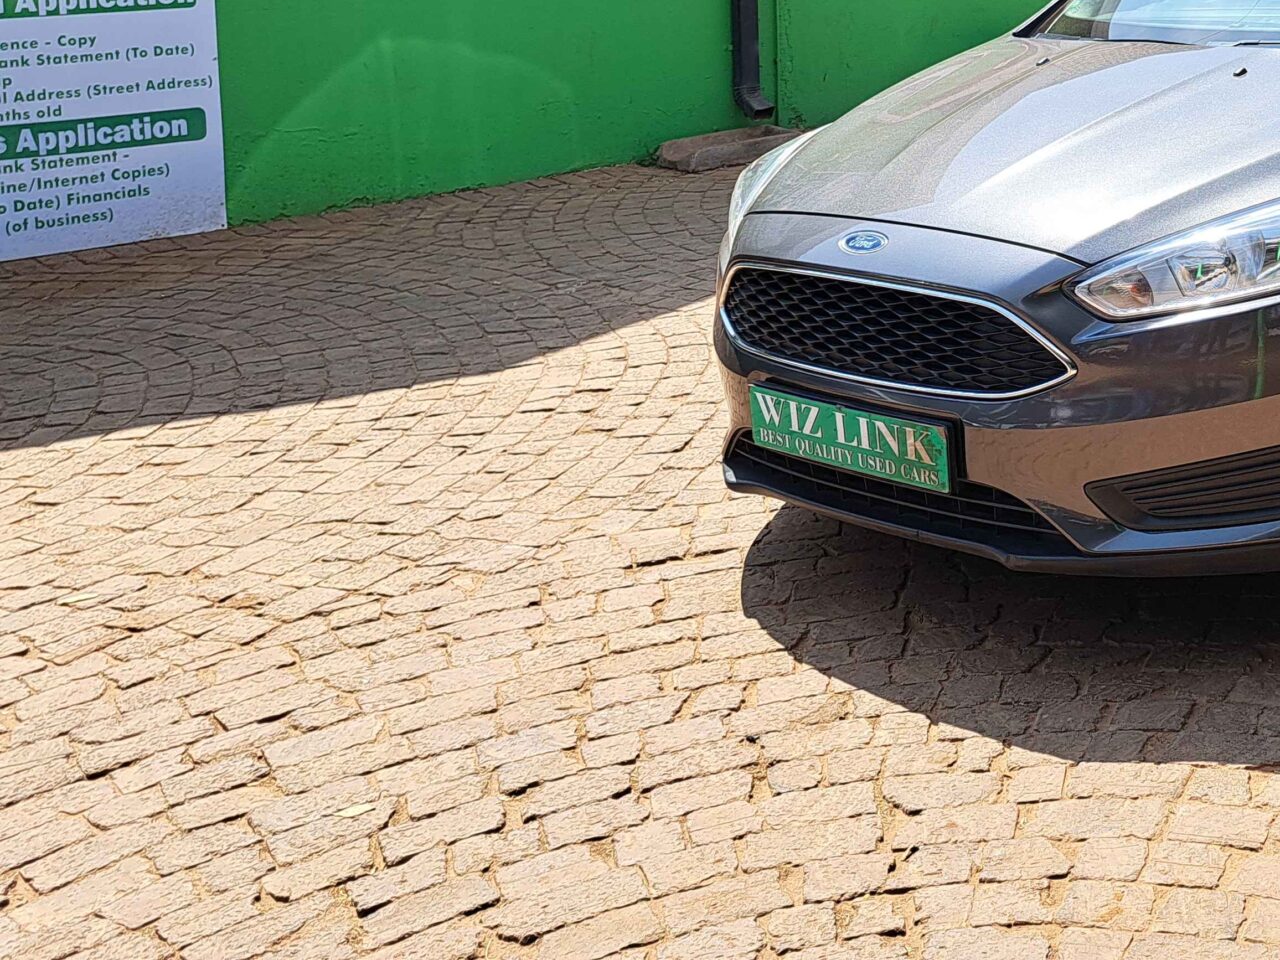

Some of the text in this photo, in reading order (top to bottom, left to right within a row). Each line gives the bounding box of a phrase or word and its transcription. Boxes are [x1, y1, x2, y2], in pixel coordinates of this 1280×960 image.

[36, 50, 120, 66] Statement
[125, 47, 148, 62] (To
[154, 43, 195, 57] Date)
[57, 35, 97, 48] Copy
[13, 87, 81, 103] Address
[87, 81, 140, 99] (Street
[146, 75, 213, 91] Address)
[36, 105, 62, 119] old
[16, 116, 187, 155] Application
[31, 151, 118, 170] Statement
[111, 162, 170, 182] Copies)
[13, 196, 60, 213] Date)
[67, 184, 150, 205] Financials
[6, 207, 114, 236] (of business)
[754, 391, 936, 466] WIZ LINK
[760, 427, 939, 486] BEST QUALITY USED CARS
